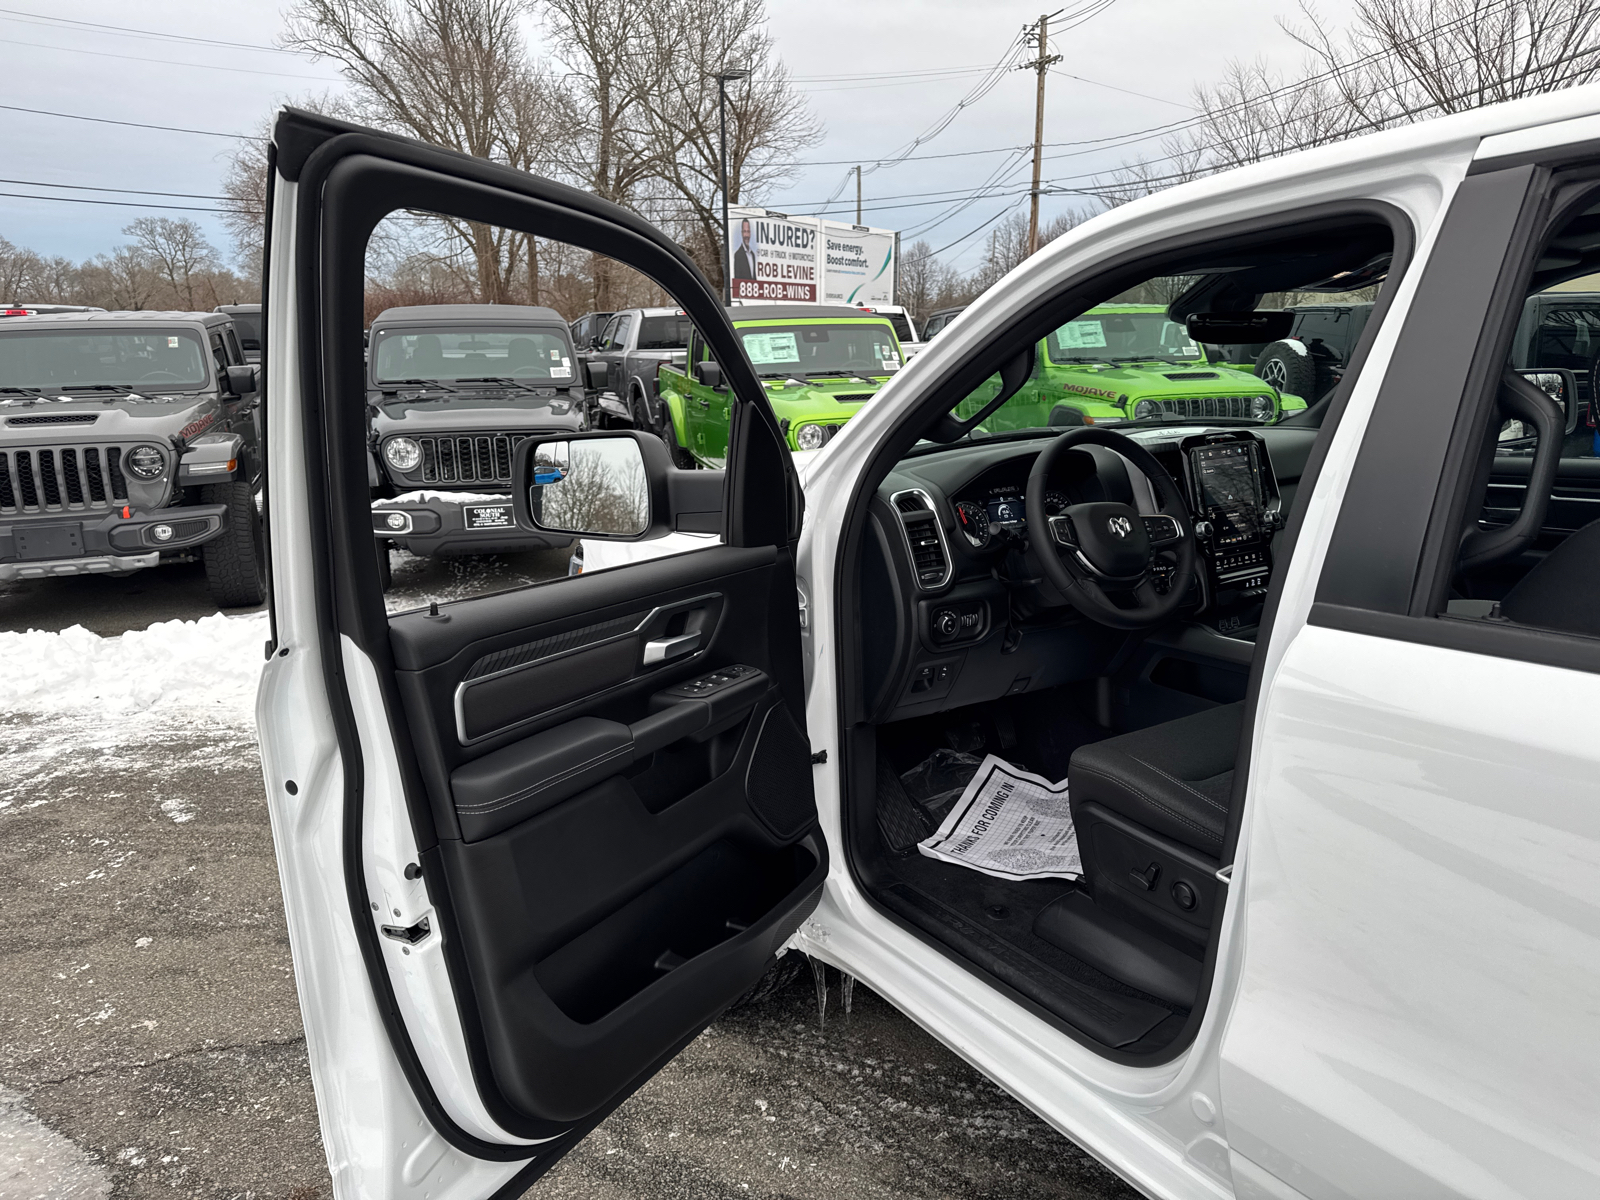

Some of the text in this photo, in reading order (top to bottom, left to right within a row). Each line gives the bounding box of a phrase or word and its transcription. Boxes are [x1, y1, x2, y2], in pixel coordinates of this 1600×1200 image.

[756, 221, 816, 250] INJURED?
[826, 239, 864, 256] Save energy.
[826, 254, 869, 268] Boost comfort.
[757, 262, 779, 278] ROB
[780, 264, 815, 281] LEVINE
[739, 281, 811, 300] 888-ROB-WINS
[1063, 383, 1117, 399] MOJAVE
[178, 414, 214, 438] MOJAVE
[473, 507, 506, 515] COLONIAL
[950, 781, 1015, 856] THANKS FOR COMING IN
[941, 914, 1007, 956] RAM
